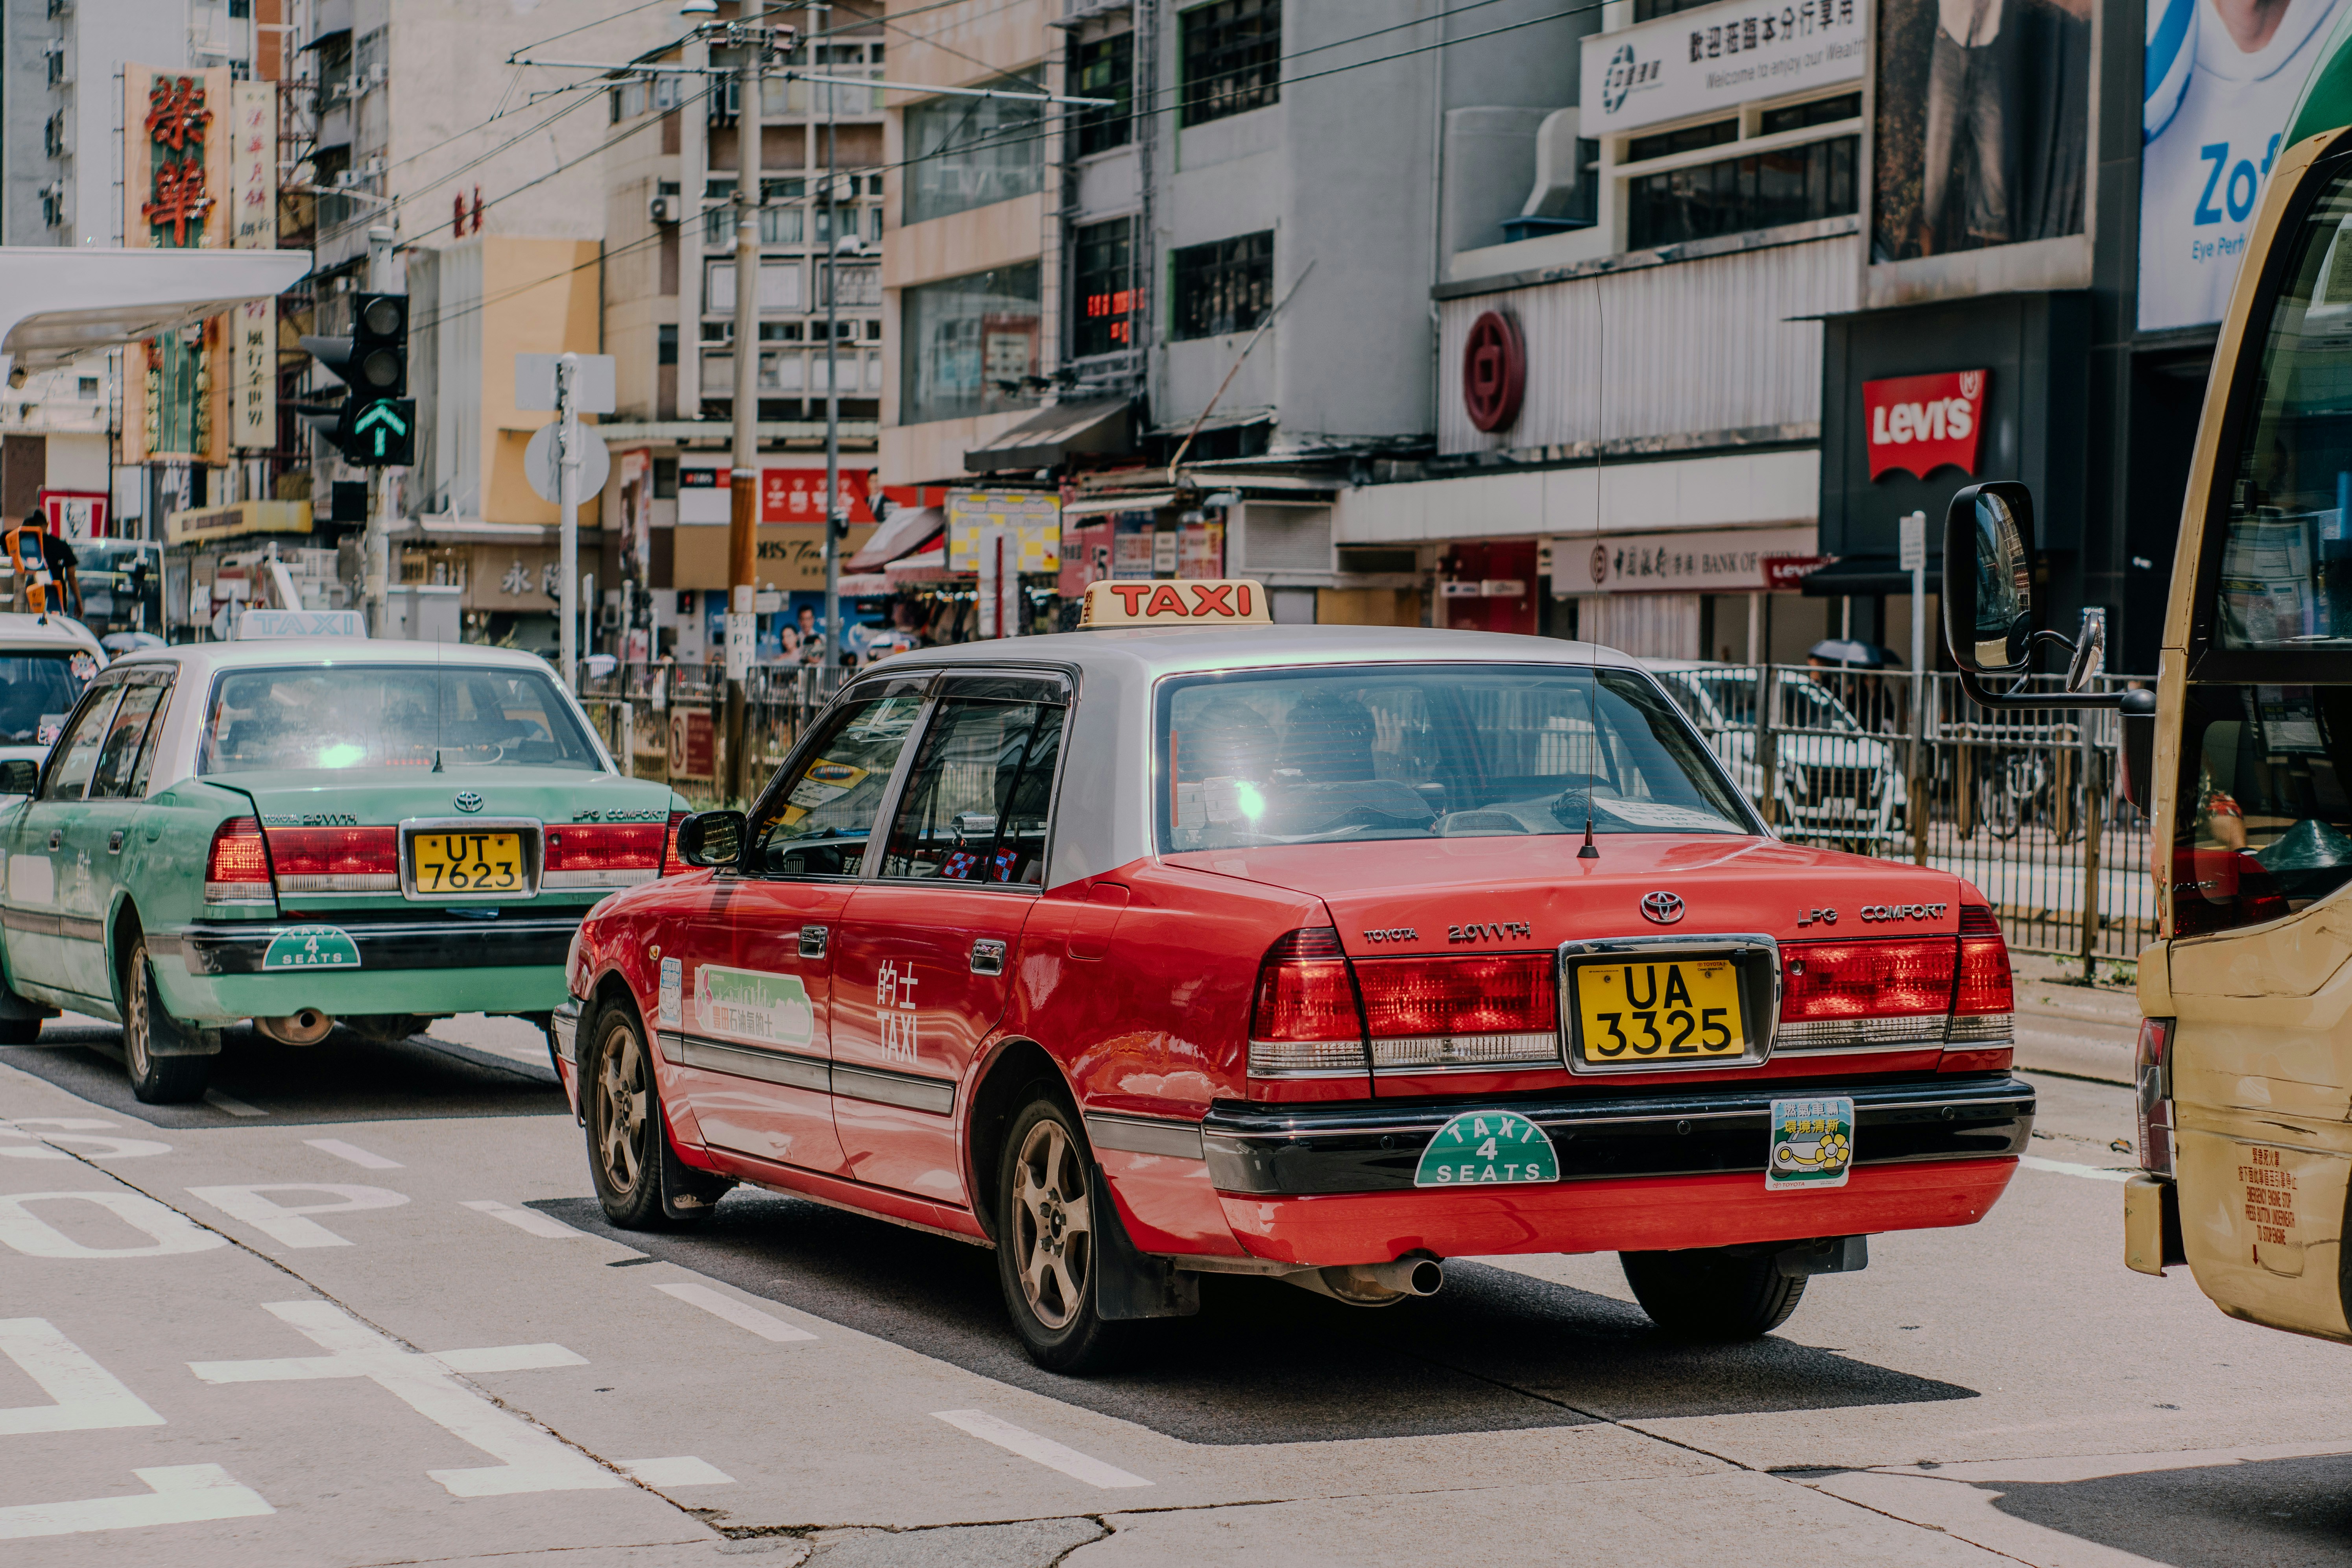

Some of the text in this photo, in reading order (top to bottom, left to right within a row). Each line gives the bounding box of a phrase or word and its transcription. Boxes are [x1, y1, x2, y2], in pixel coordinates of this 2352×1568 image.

[1705, 67, 1754, 89] Welcome
[2192, 240, 2214, 262] Eye
[1702, 552, 1758, 574] BANK OF
[1084, 590, 1093, 617] 的士
[1110, 585, 1251, 617] TAXI
[253, 613, 353, 635] TAXI
[264, 814, 299, 823] TOYOTA
[573, 808, 666, 820] LPG COMFORT
[446, 835, 489, 862] UT
[425, 862, 515, 889] 7623
[1798, 903, 1948, 925] LPG COMFORT
[288, 927, 336, 940] TAXI
[305, 935, 319, 954] 4
[1364, 927, 1419, 941] TOYOTA
[282, 953, 342, 964] SEATS
[877, 960, 918, 1010] 的士
[1624, 964, 1693, 1010] UA
[713, 1005, 773, 1038] 豐田石油氣的士
[1597, 1008, 1732, 1057] 3325
[877, 1010, 917, 1064] TAXI
[1783, 1101, 1839, 1117] 燃氣車輛
[1447, 1116, 1534, 1143] TAXI
[1783, 1118, 1839, 1134] 環境清新
[1476, 1137, 1497, 1160] 4
[1436, 1163, 1540, 1182] SEATS
[2246, 1186, 2291, 1208] EMERGENCY ENGINE STOP
[2245, 1204, 2295, 1228] PRESS BUTTON UNDERNEATH
[2257, 1224, 2286, 1245] TO STOP ENGINE
